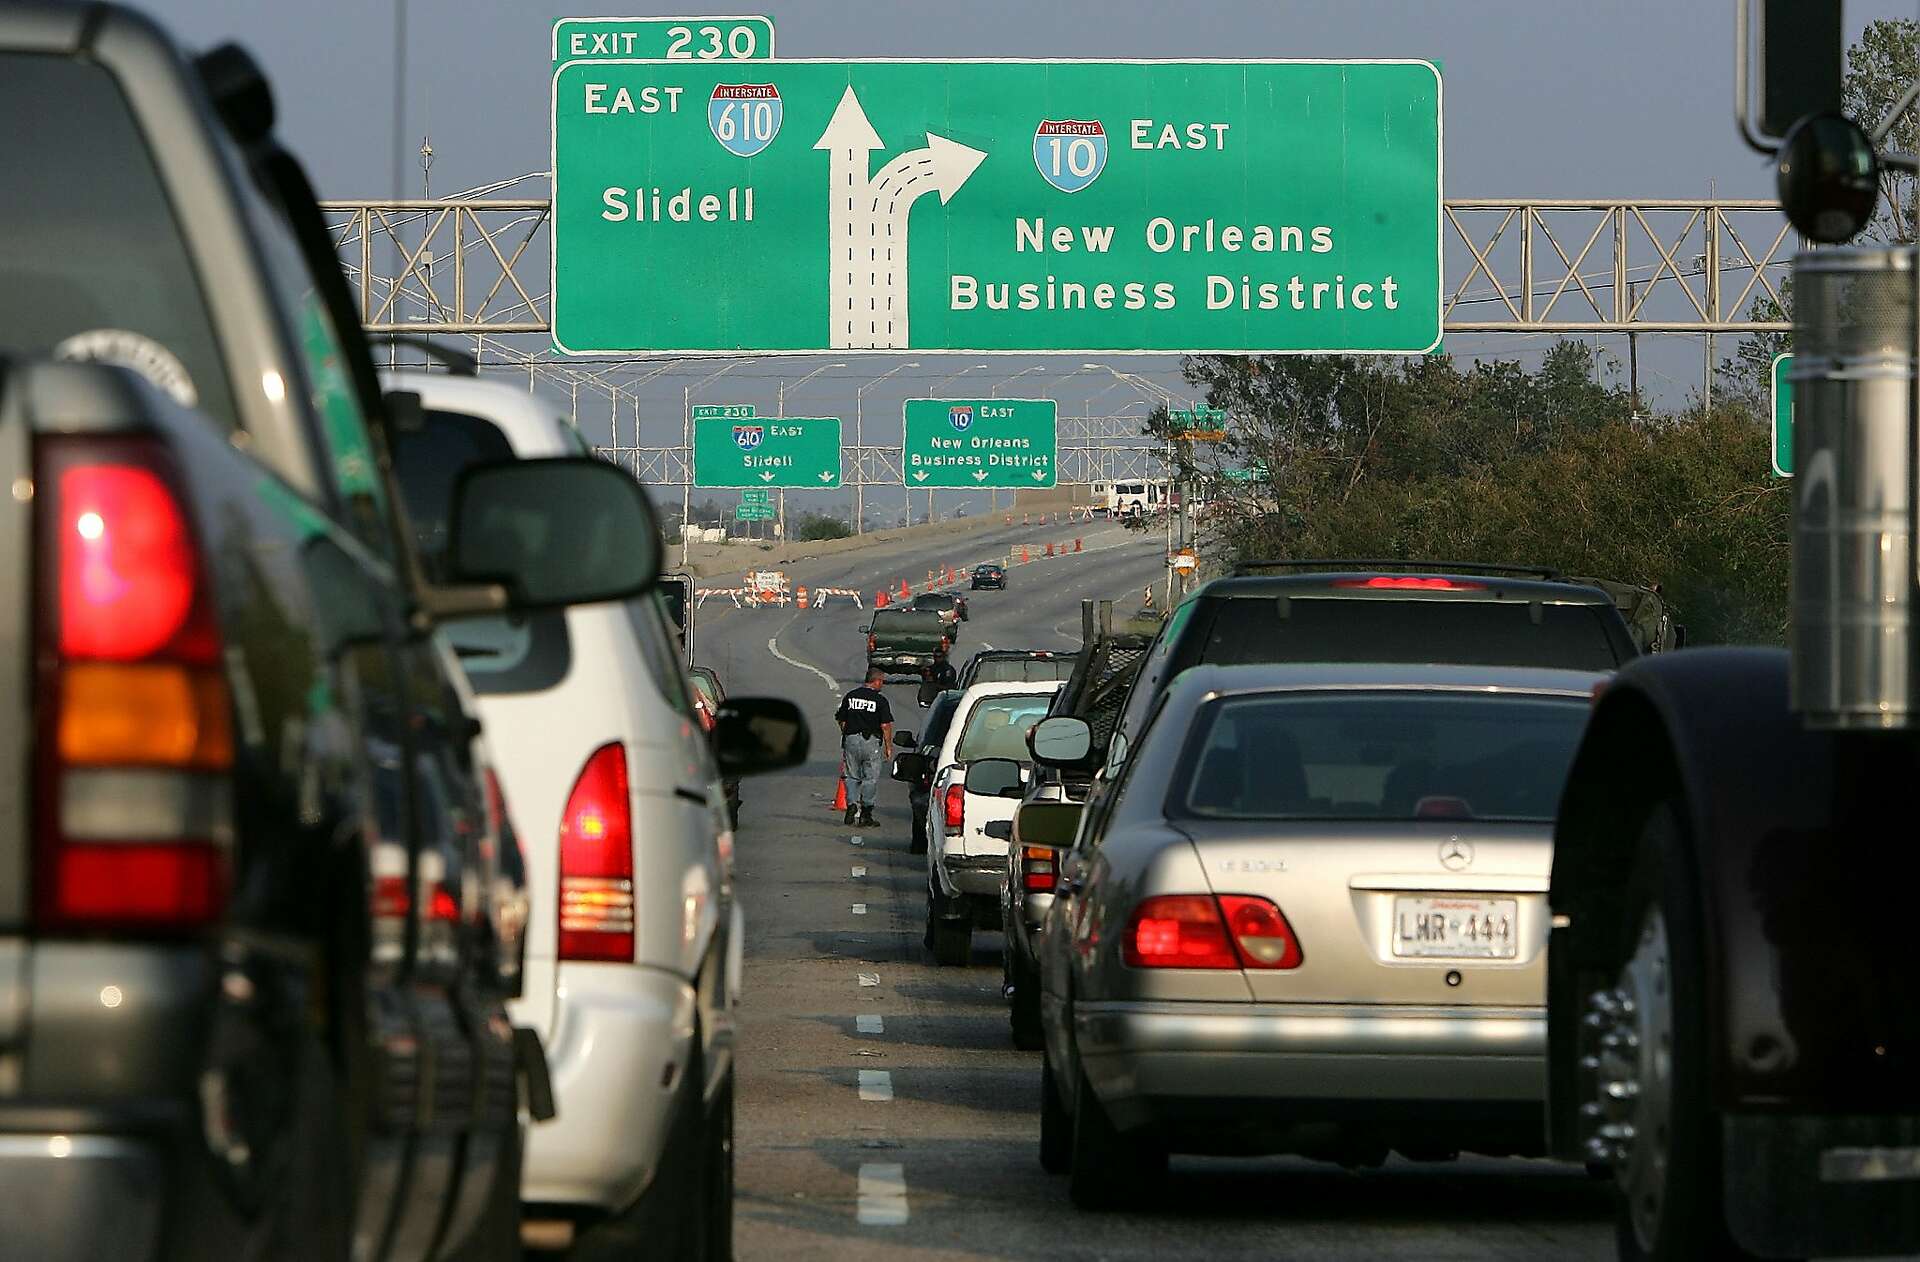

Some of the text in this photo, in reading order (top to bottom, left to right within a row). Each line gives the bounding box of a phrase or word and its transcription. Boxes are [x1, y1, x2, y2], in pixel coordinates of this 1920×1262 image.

[570, 26, 756, 58] EXIT 230
[585, 84, 684, 114] EAST
[719, 87, 773, 98] INTERSTATE
[717, 102, 773, 142] 610
[1045, 122, 1098, 135] INTERSTATE
[1131, 119, 1230, 150] EAST
[1049, 137, 1098, 178] 10
[602, 186, 753, 222] Slidell
[1016, 217, 1333, 253] New Orleans
[951, 275, 1399, 311] Business District
[699, 407, 748, 417] EXIT 230
[980, 405, 1015, 418] EAST
[953, 413, 969, 427] 10
[770, 425, 804, 437] EAST
[737, 431, 760, 446] 610
[931, 436, 1030, 449] New Orleans
[743, 455, 792, 467] Slidell
[911, 453, 1048, 467] Business District
